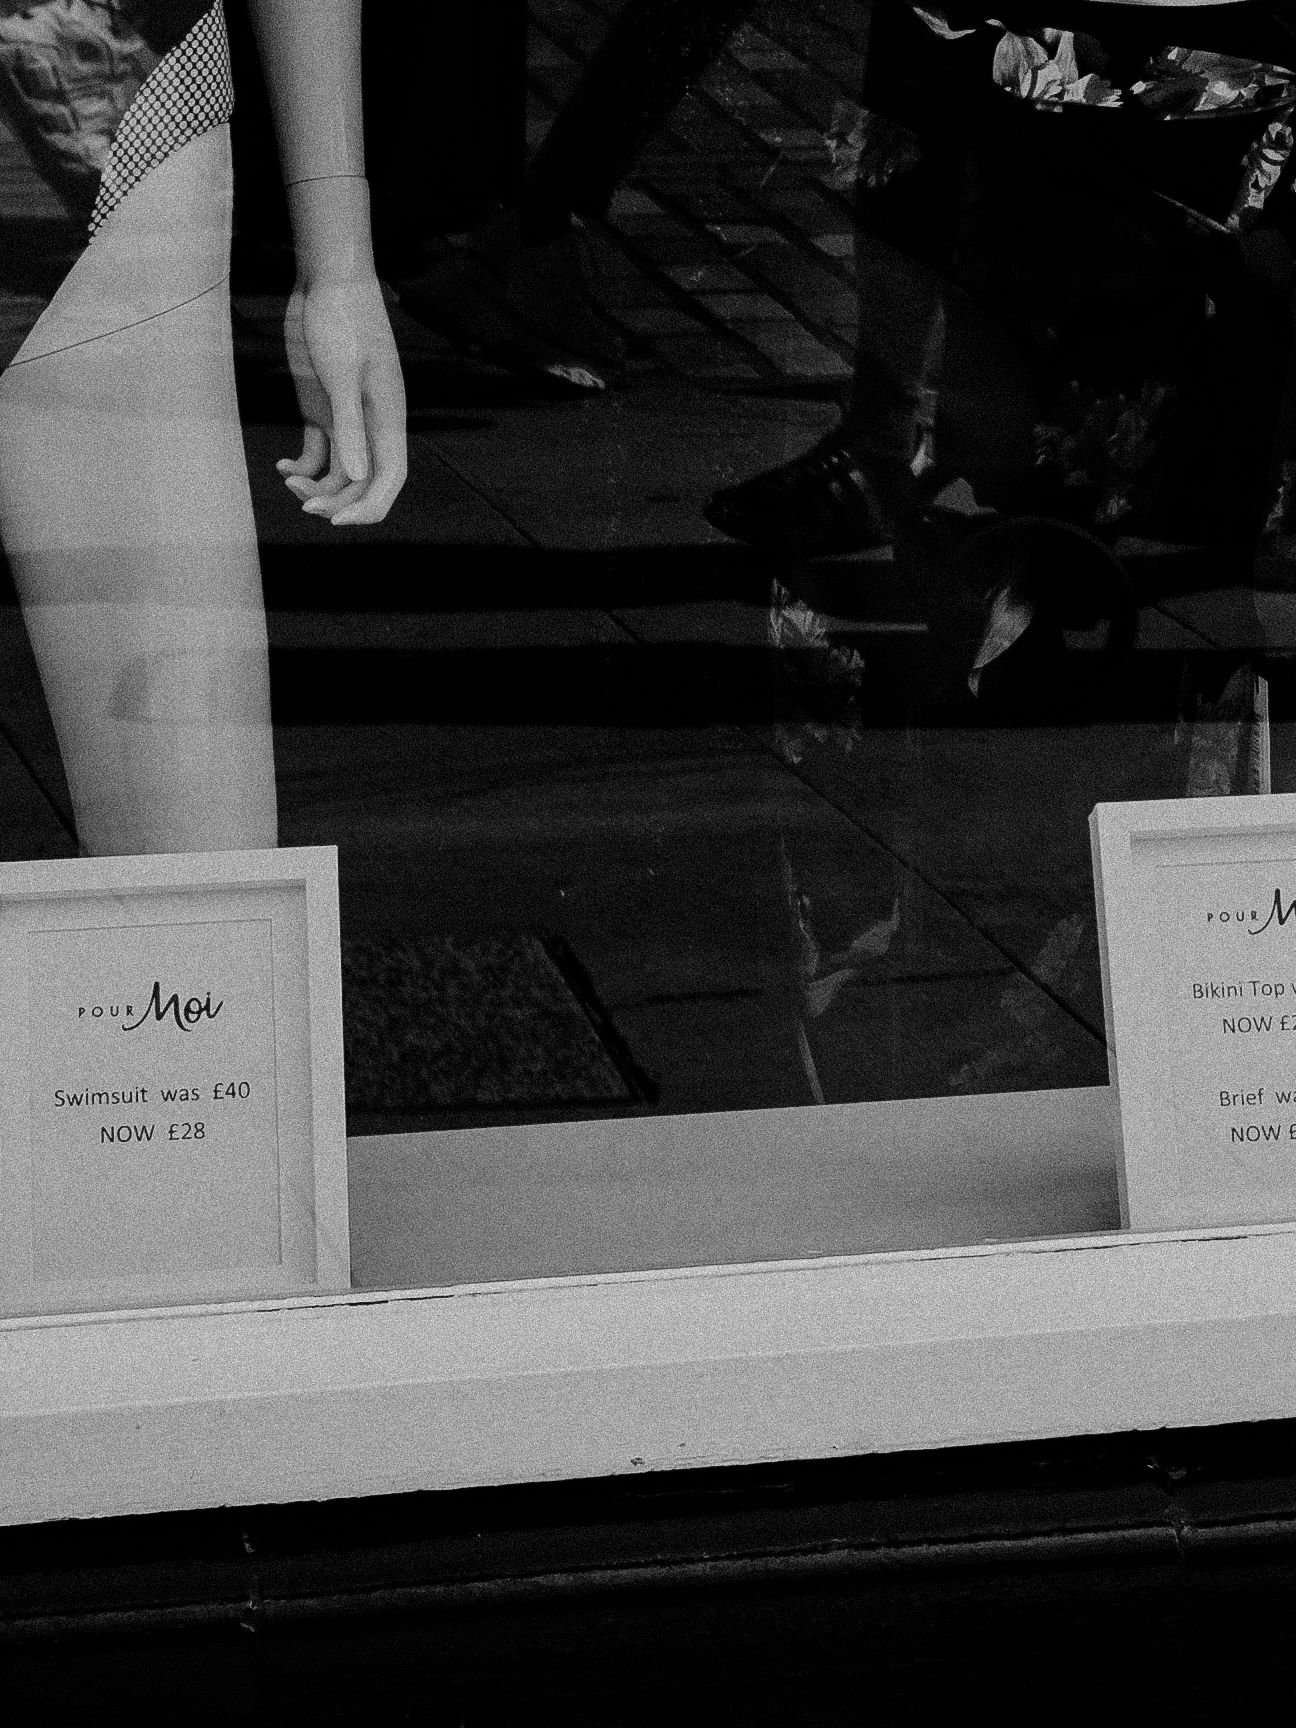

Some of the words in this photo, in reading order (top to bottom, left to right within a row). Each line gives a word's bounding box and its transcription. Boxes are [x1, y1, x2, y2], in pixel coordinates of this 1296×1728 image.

[1207, 910, 1259, 923] POUR
[1192, 979, 1244, 1000] Bikini
[1249, 980, 1286, 999] Top
[78, 1004, 136, 1019] POUR
[122, 981, 223, 1032] Moi
[1222, 1016, 1273, 1034] NOW
[54, 1085, 148, 1107] Swimsuit
[161, 1087, 200, 1102] was
[213, 1081, 251, 1100] £40
[1219, 1087, 1265, 1107] Brief
[100, 1124, 155, 1143] NOW
[168, 1122, 205, 1141] £28
[1231, 1124, 1281, 1142] NOW
